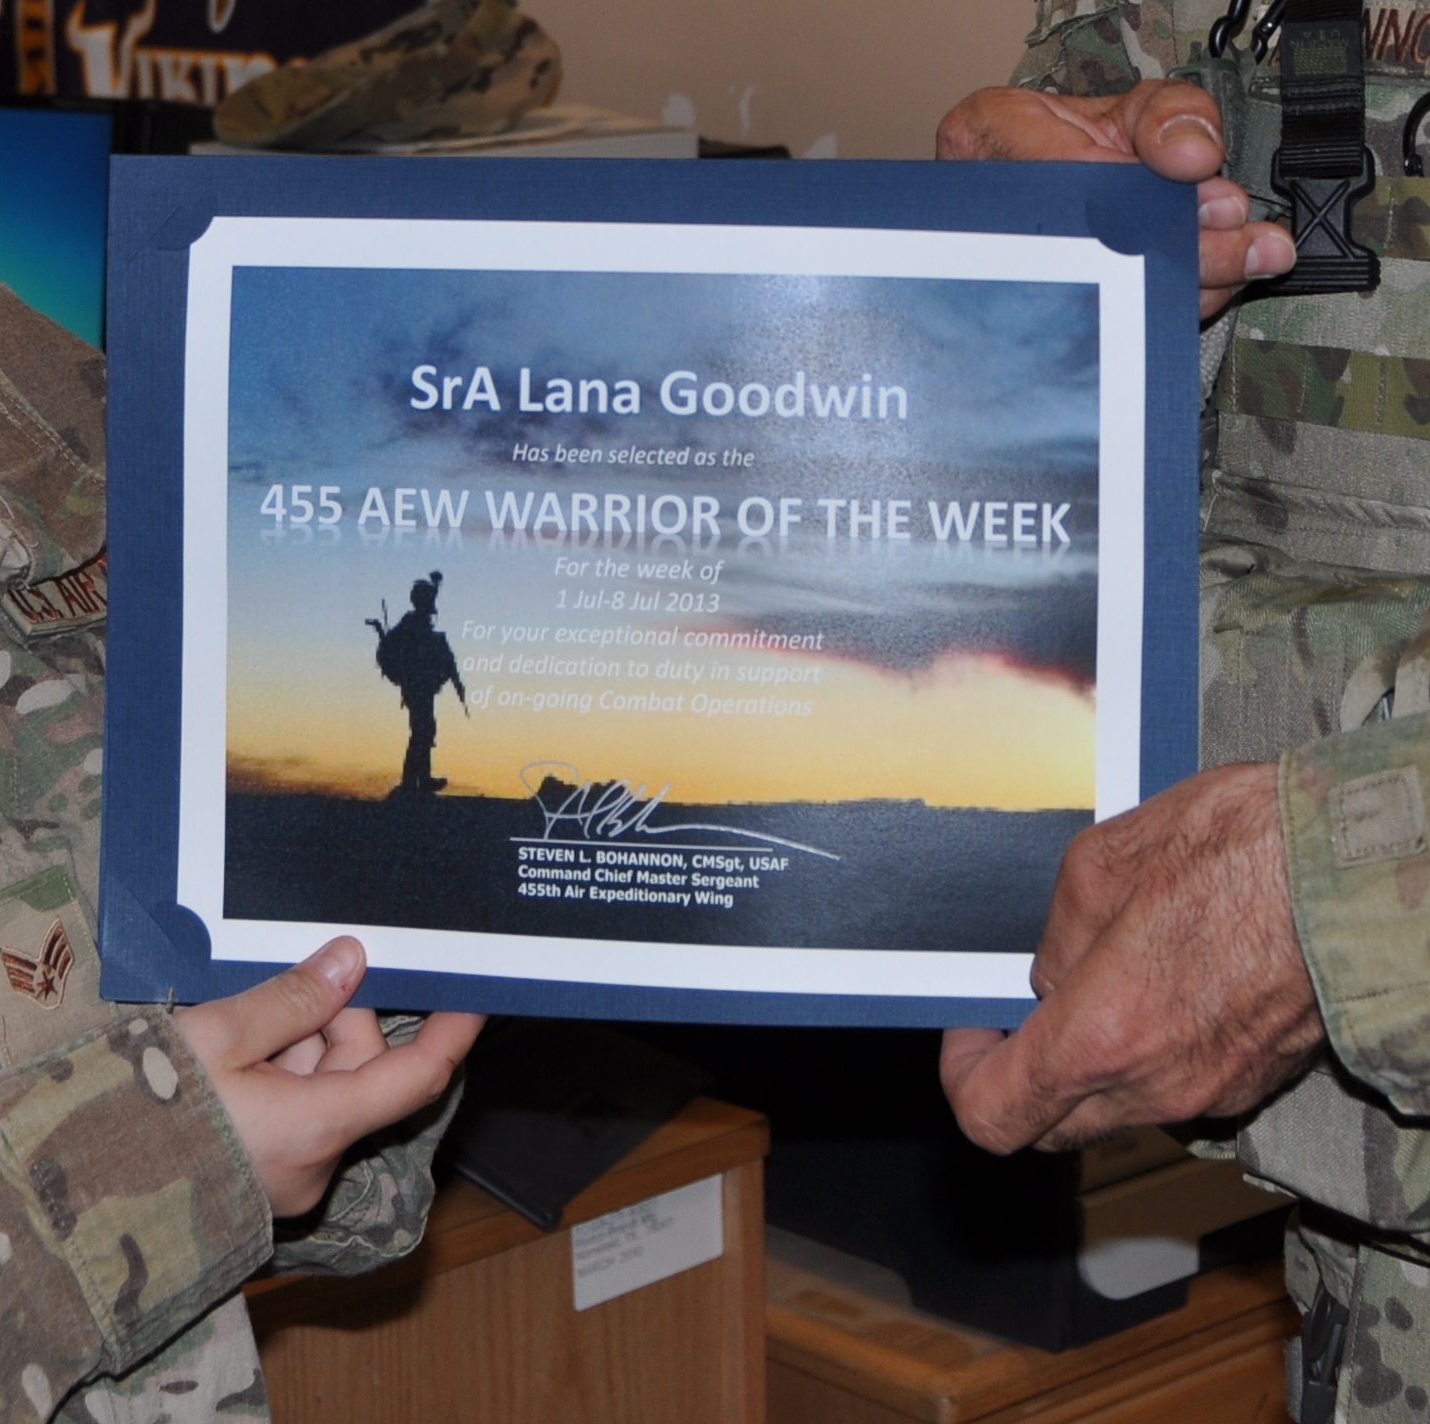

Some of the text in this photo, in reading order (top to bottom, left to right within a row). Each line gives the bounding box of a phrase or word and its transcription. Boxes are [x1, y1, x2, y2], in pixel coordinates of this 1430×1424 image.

[410, 364, 909, 419] SrA Lana Goodwin
[512, 443, 755, 468] Has been selected as the
[260, 484, 1072, 543] 455 AEW WARRIOR OF THE WEEK
[554, 556, 725, 585] For the week of
[54, 568, 108, 617] AIR
[555, 590, 721, 613] 1 Jul-8 Jul 2013
[461, 621, 825, 651] For your exceptional commitment
[462, 654, 823, 687] and dedication to duty in support
[470, 685, 814, 718] of on-going Combat Operations
[518, 847, 789, 872] STEVEN L. BOHANNON, CMSgt, USAF
[518, 864, 760, 890] Command Chief Master Sergeant
[518, 882, 734, 909] 455th Air Expeditionary Wing
